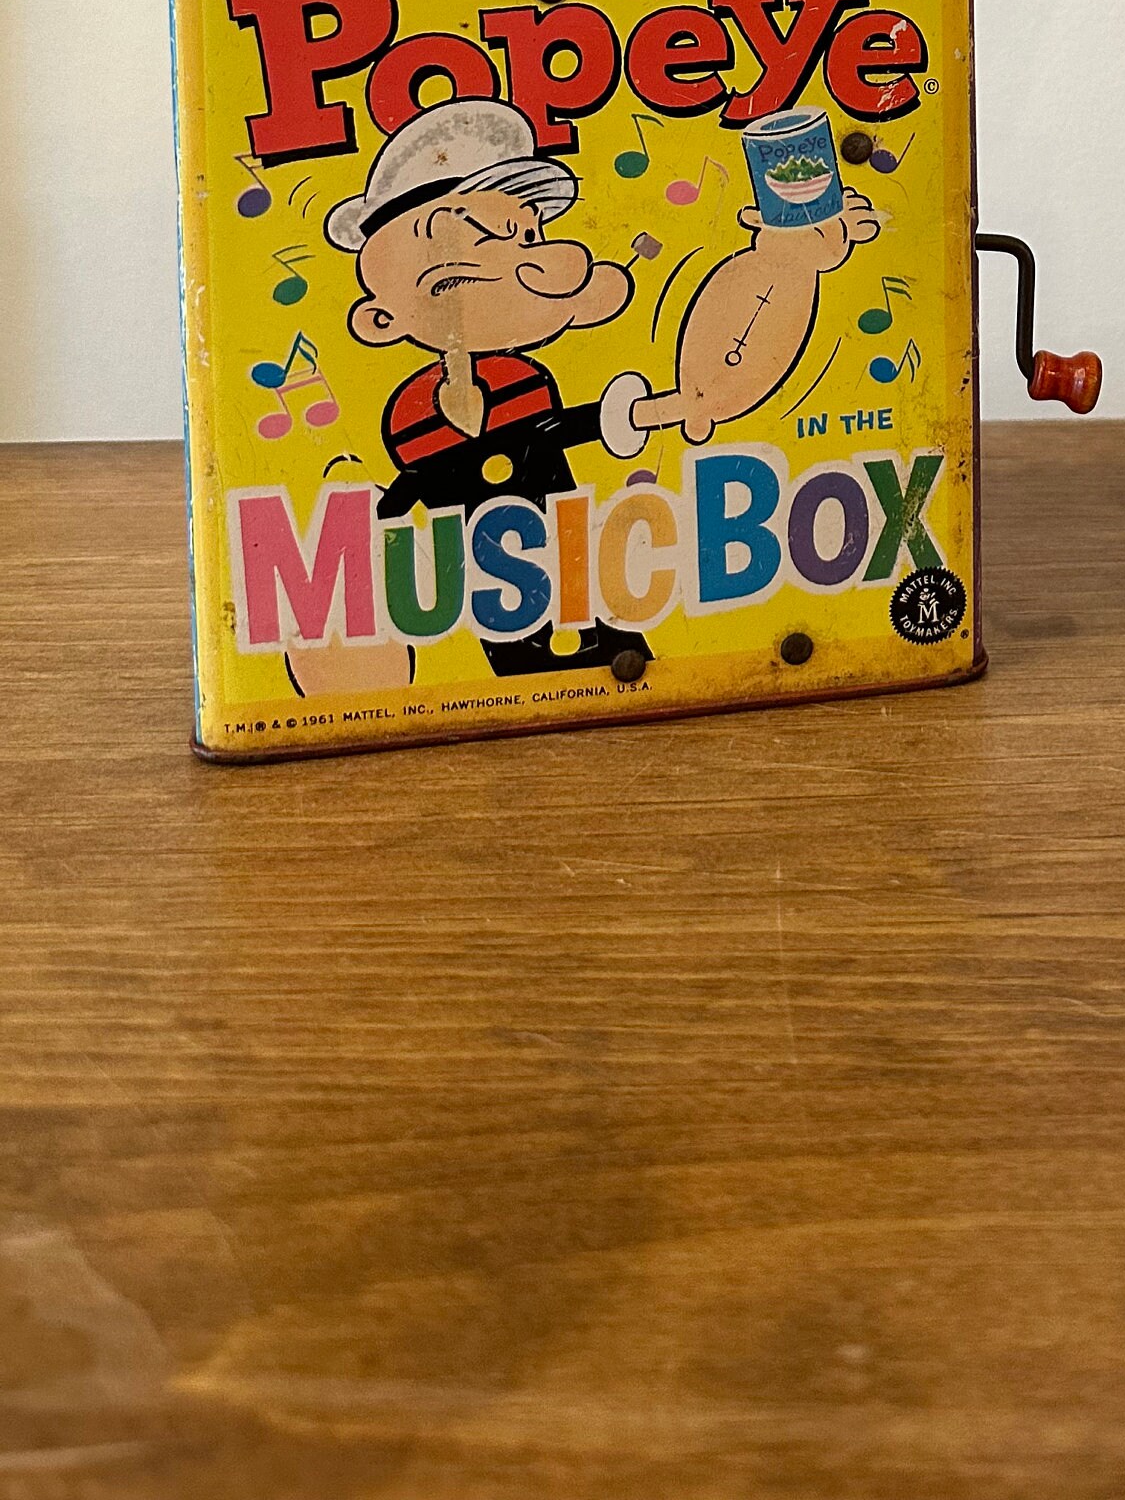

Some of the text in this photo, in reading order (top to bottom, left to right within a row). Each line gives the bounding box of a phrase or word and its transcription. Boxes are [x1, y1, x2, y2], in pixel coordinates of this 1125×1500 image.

[757, 135, 828, 163] Popeye
[797, 407, 894, 439] IN THE
[234, 452, 946, 647] MUSIC BOX
[899, 607, 959, 638] TOYMAKERS
[271, 719, 282, 730] &
[302, 713, 335, 727] 1961
[342, 707, 396, 723] MATTEL,
[403, 703, 435, 716] INC.,
[441, 695, 526, 713] HAWTHORNE,
[531, 686, 611, 703] CALIFORNIA,
[616, 681, 654, 694] U.S.A.
